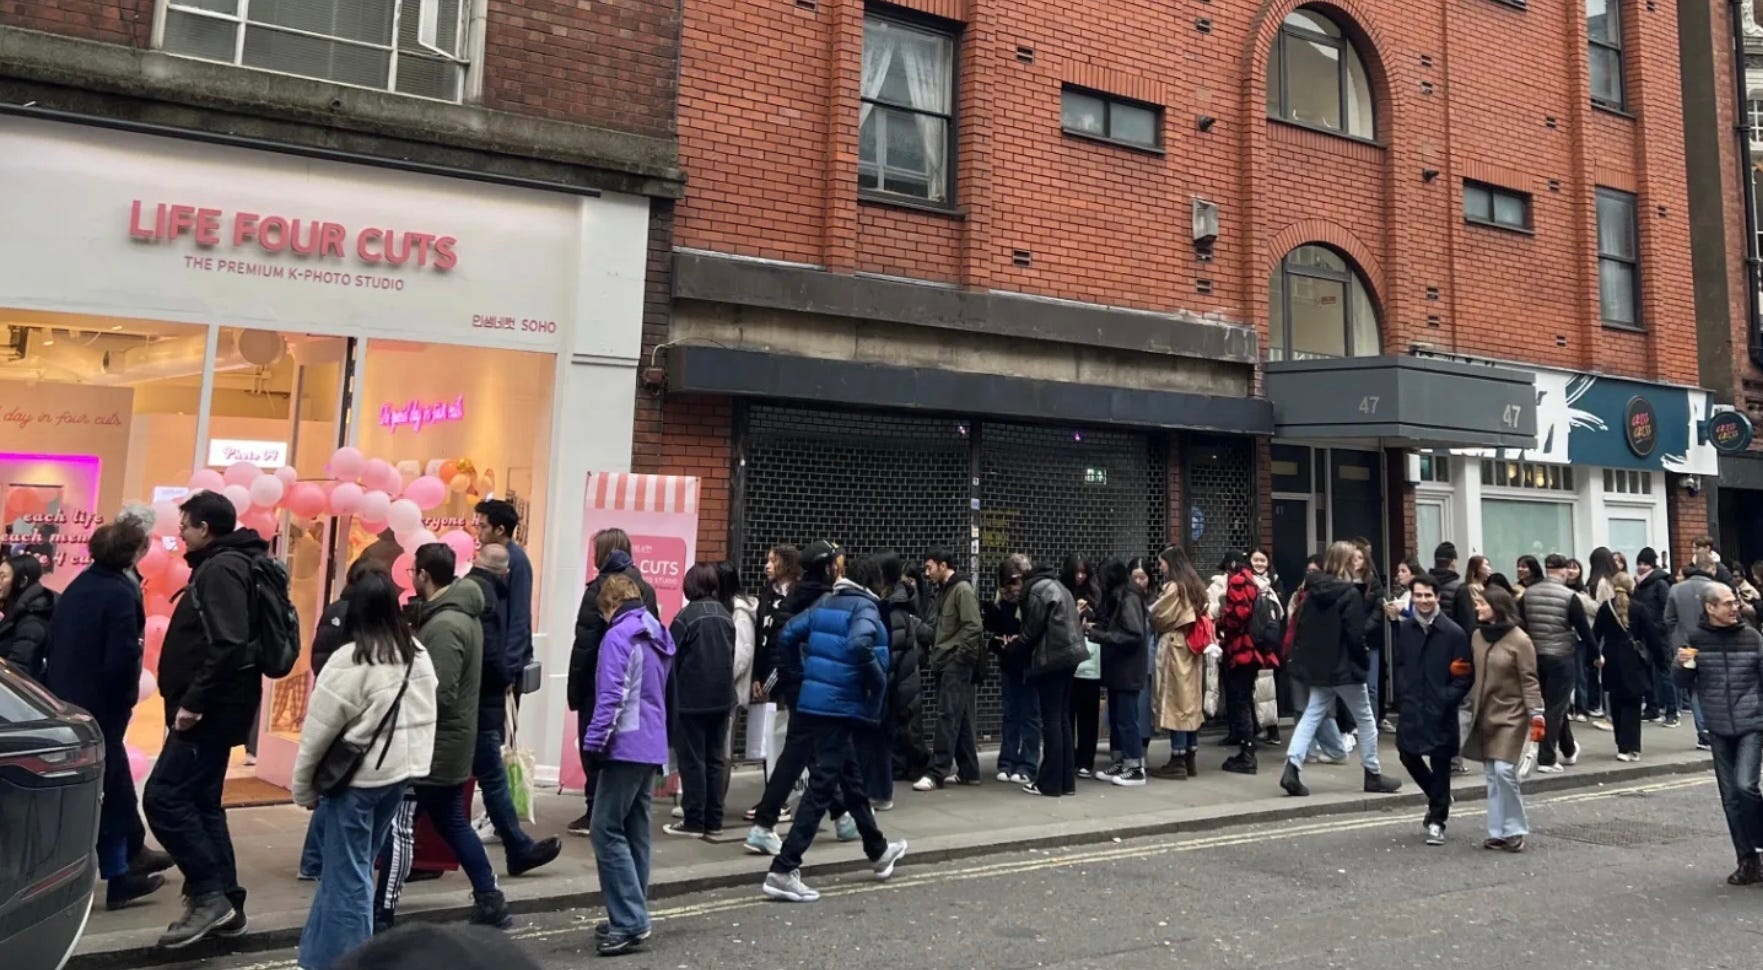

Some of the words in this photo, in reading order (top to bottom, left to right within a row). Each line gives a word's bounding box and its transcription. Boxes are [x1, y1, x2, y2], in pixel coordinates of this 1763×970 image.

[130, 200, 222, 246] LIFE
[233, 212, 346, 259] FOUR
[357, 227, 458, 271] CUTS
[184, 255, 213, 271] THE
[217, 260, 284, 278] PREMIUM
[288, 267, 350, 286] K-PHOTO
[354, 274, 404, 291] STUDIO
[521, 319, 557, 333] SOHO
[1359, 396, 1379, 415] 47
[4, 405, 32, 429] day
[37, 413, 52, 423] in
[56, 410, 88, 426] four
[95, 411, 121, 425] cuts
[1503, 404, 1521, 428] 47
[23, 509, 67, 524] each
[74, 508, 104, 528] life
[0, 528, 43, 544] each
[640, 559, 679, 576] CUTS
